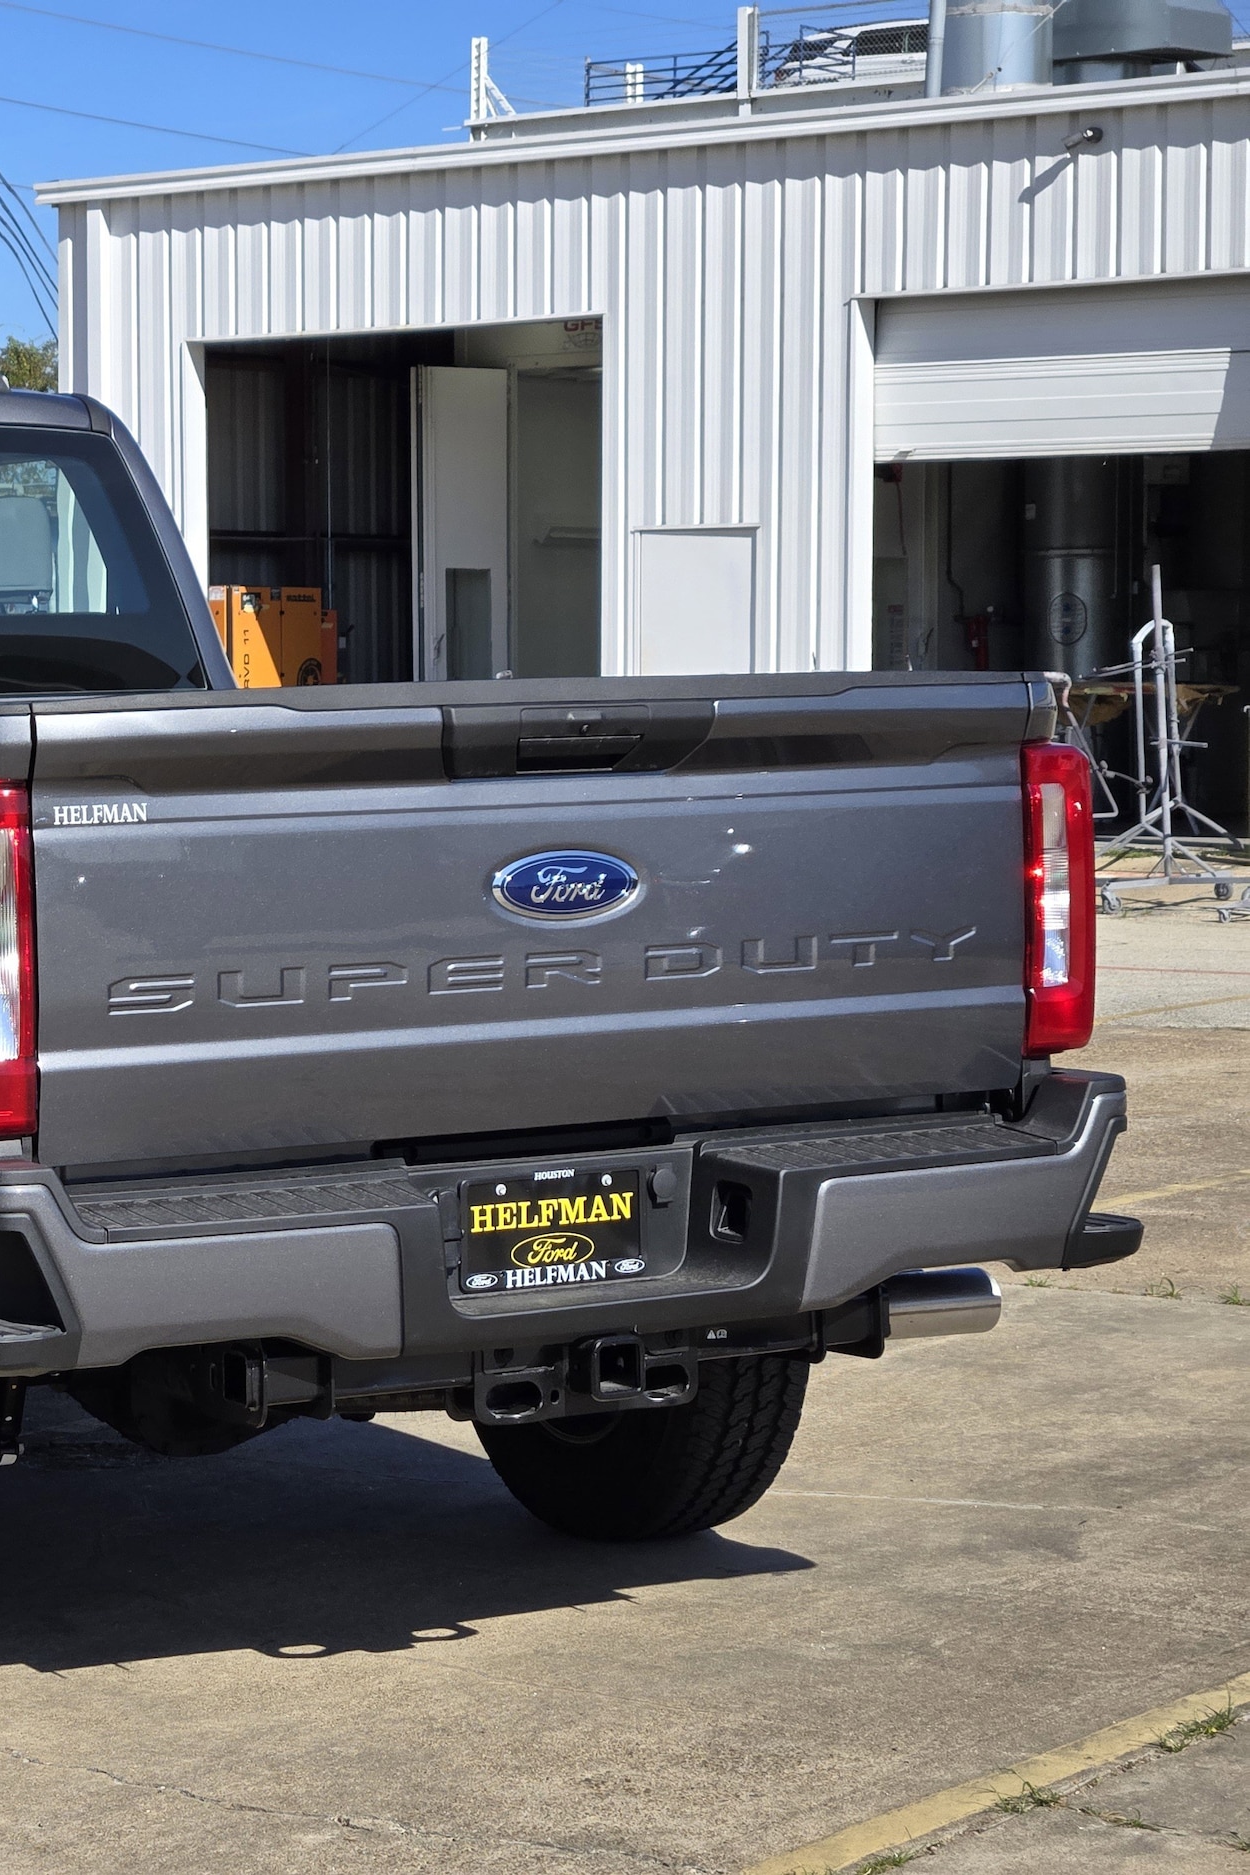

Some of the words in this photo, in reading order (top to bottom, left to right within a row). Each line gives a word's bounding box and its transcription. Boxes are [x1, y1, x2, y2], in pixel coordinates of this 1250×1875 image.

[53, 803, 148, 826] HELFMAN
[530, 865, 608, 904] Ford
[108, 949, 602, 1016] SUPER
[645, 925, 977, 981] DUTY
[534, 1168, 575, 1181] HOUSTON
[470, 1191, 634, 1234] HELFMAN
[527, 1237, 579, 1265] Ford
[505, 1259, 609, 1289] HELFMAN
